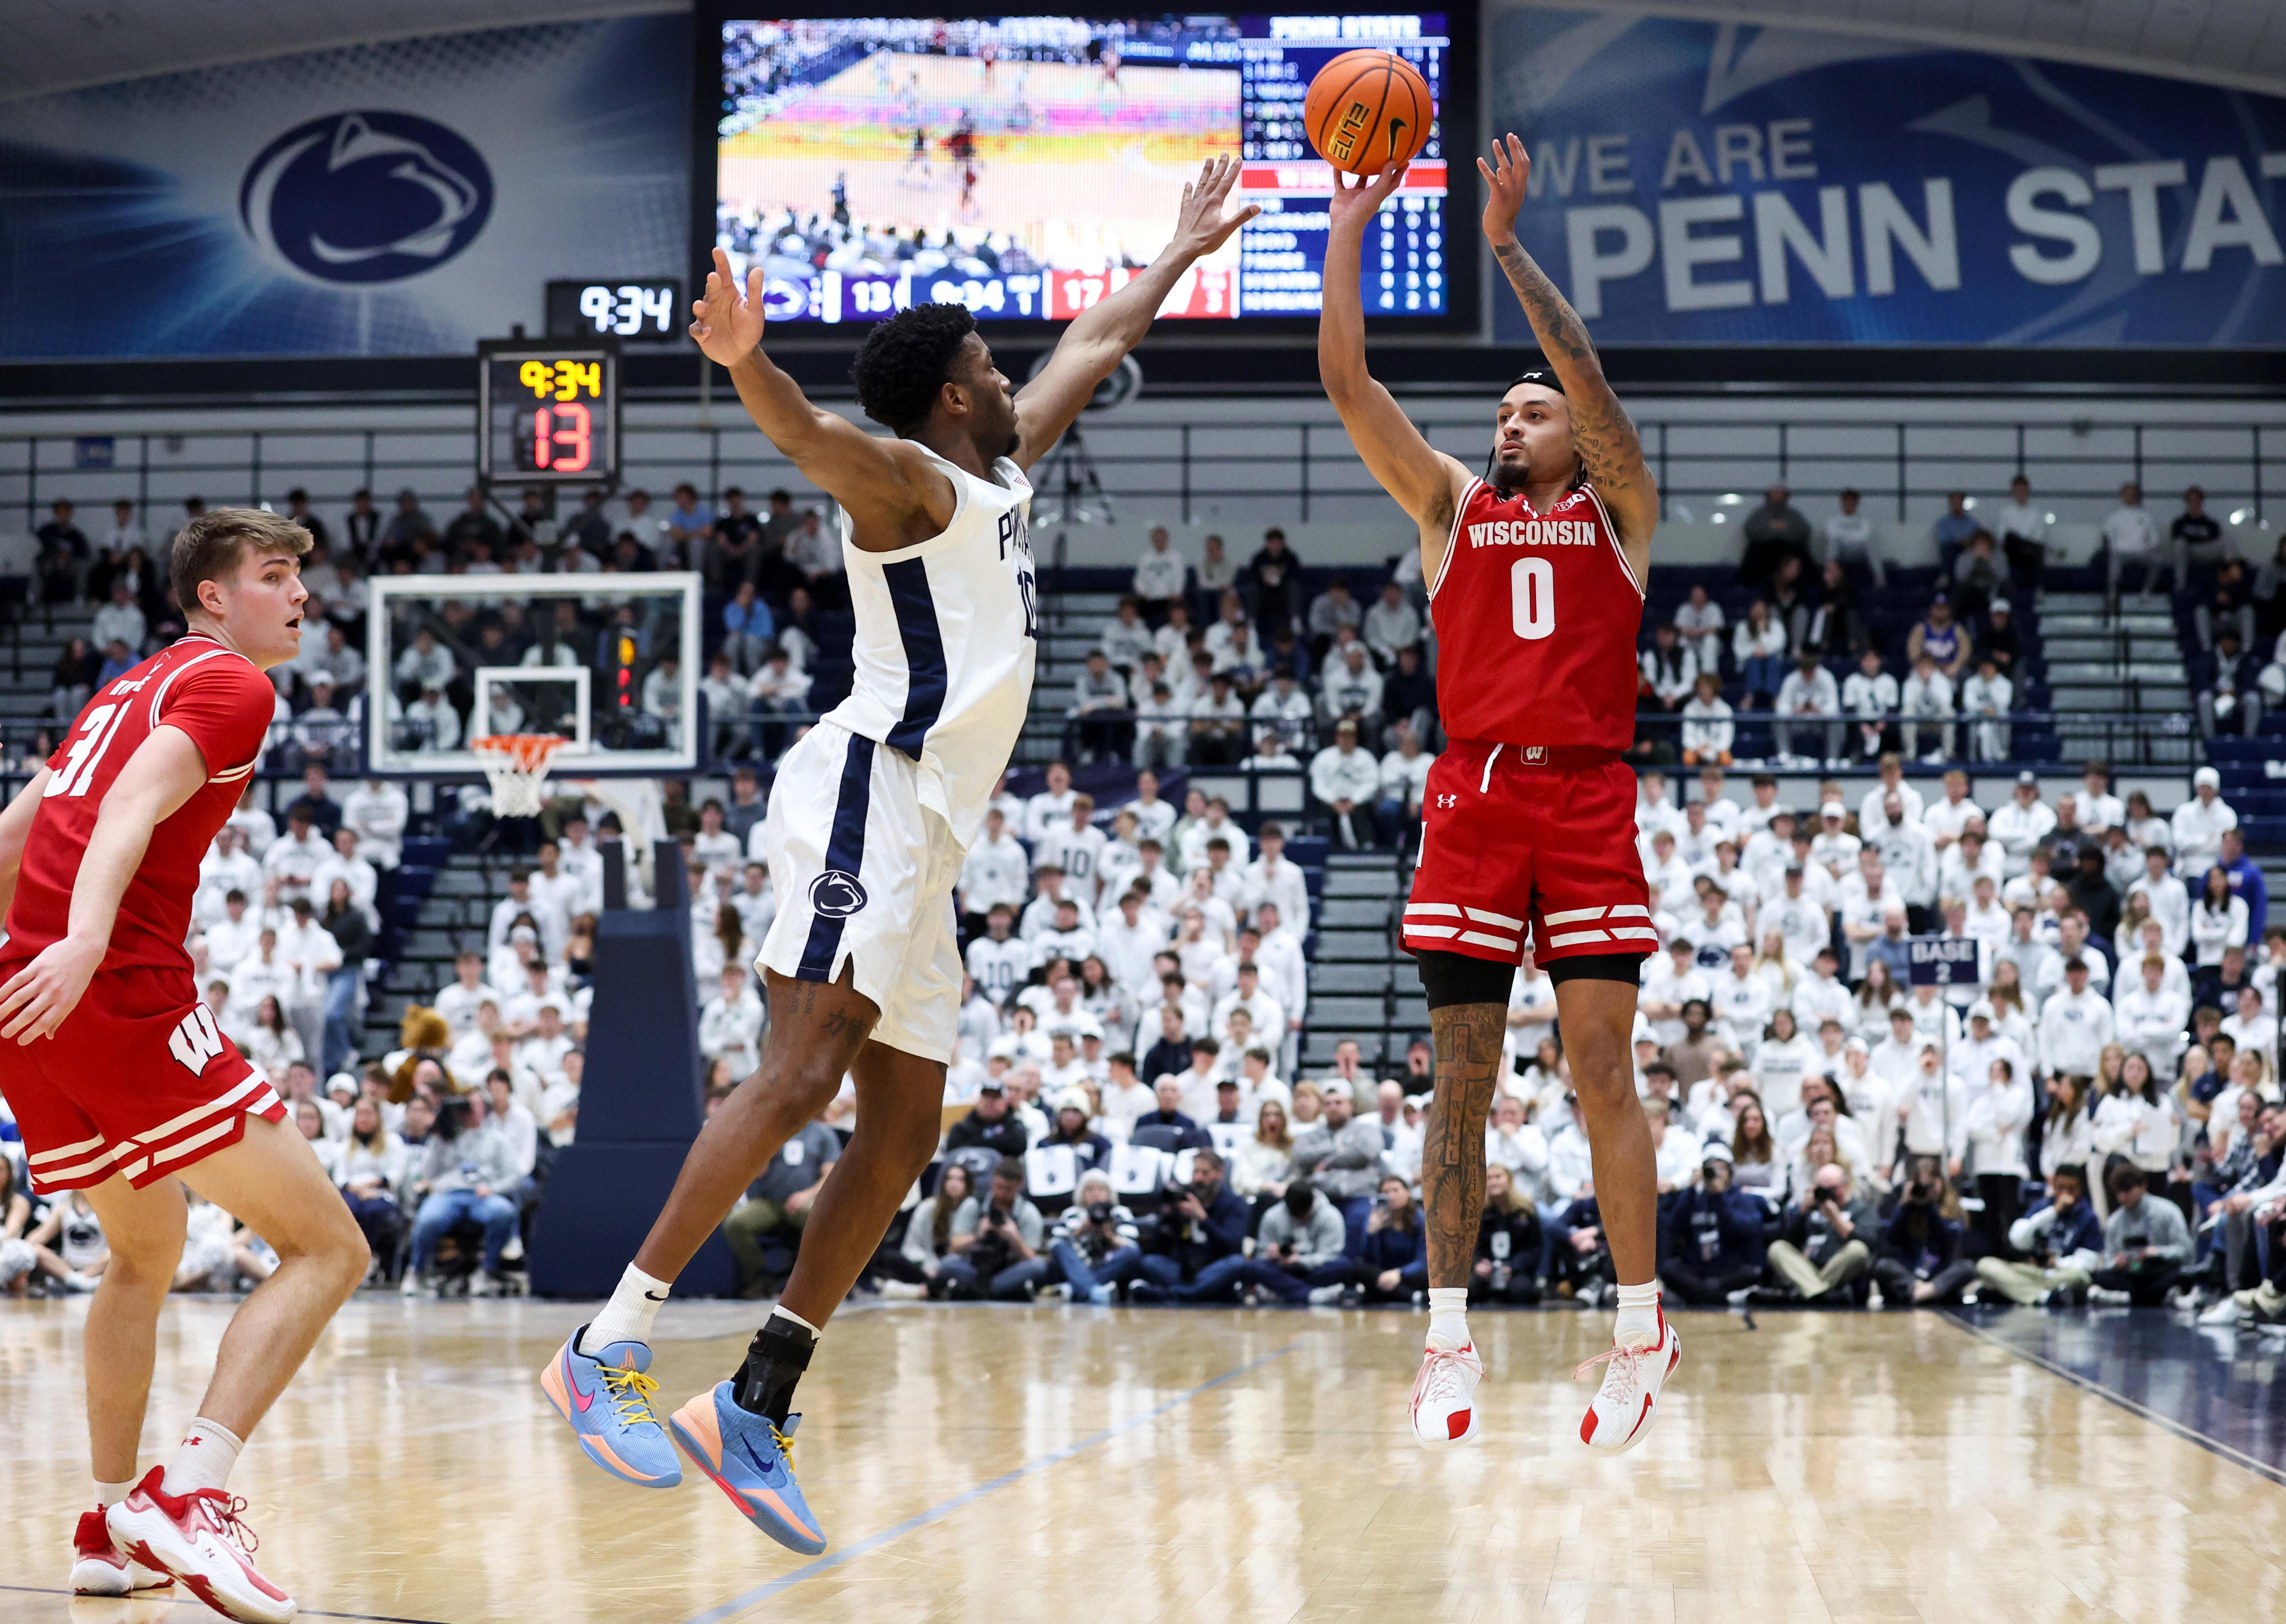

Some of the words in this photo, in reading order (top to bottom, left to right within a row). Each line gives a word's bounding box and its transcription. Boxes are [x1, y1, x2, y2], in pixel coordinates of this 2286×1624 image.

[1332, 101, 1371, 163] ELITE
[1524, 134, 1635, 199] WE
[1661, 118, 1819, 189] ARE
[1564, 177, 1961, 320] PENN
[2006, 154, 2286, 285] STA
[580, 286, 673, 335] 9:34
[520, 360, 600, 401] 9:34
[535, 403, 591, 472] 13
[1468, 521, 1596, 549] WISCONSIN
[1017, 565, 1038, 641] 10
[1511, 556, 1555, 640] 0
[43, 698, 134, 798] 31
[1526, 746, 1544, 760] W
[1063, 849, 1090, 878] 10
[1935, 963, 1952, 983] 2
[168, 1002, 224, 1078] W
